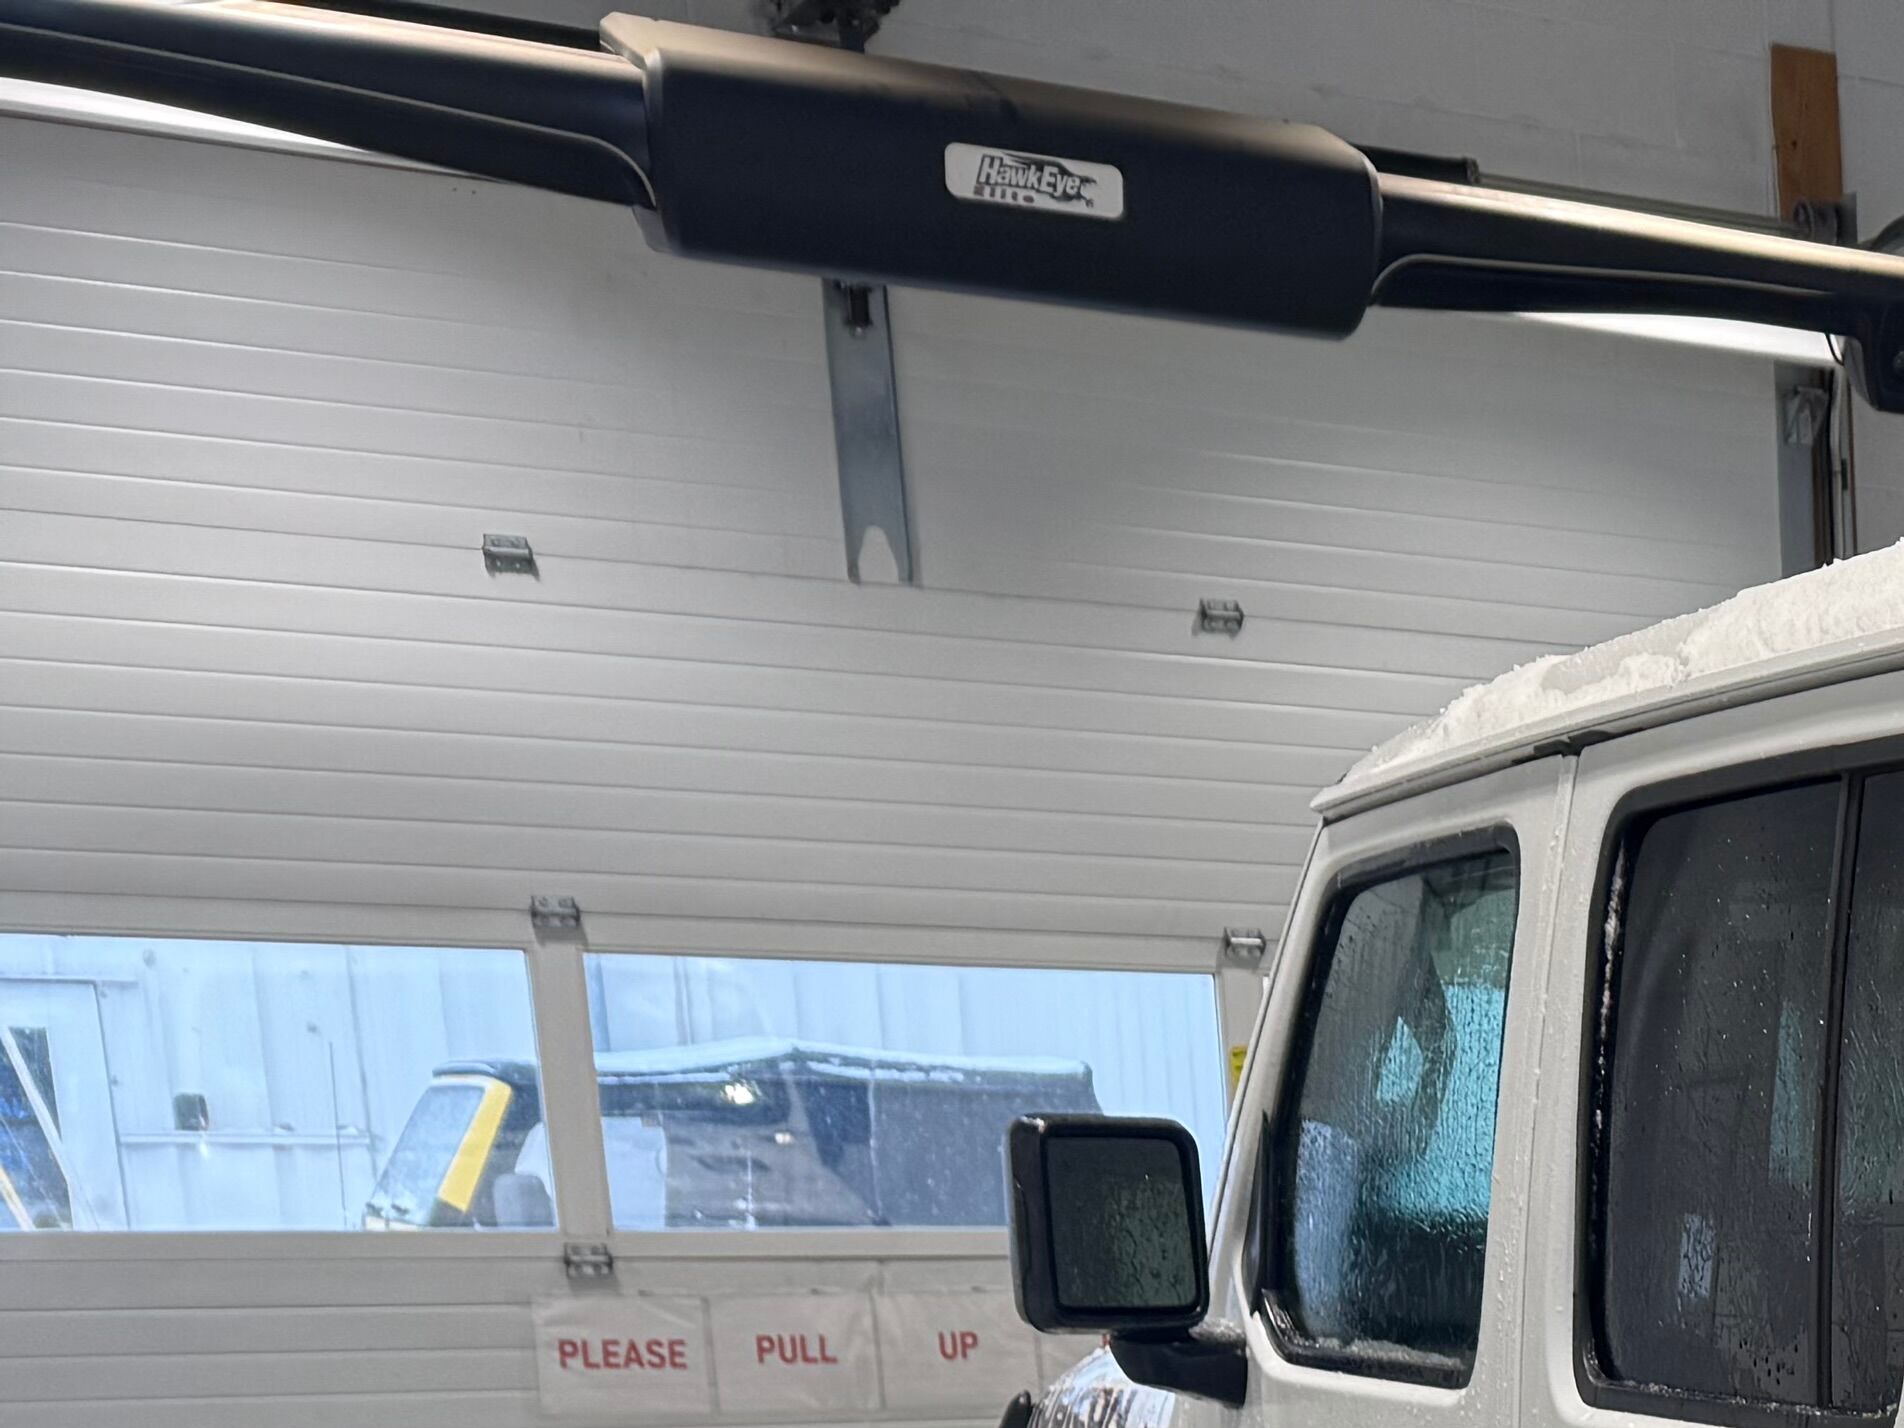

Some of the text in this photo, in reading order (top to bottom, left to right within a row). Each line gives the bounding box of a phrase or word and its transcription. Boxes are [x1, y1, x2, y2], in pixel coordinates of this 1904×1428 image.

[977, 154, 1081, 198] HawkEye
[558, 1331, 979, 1369] PLEASE PULL UP
